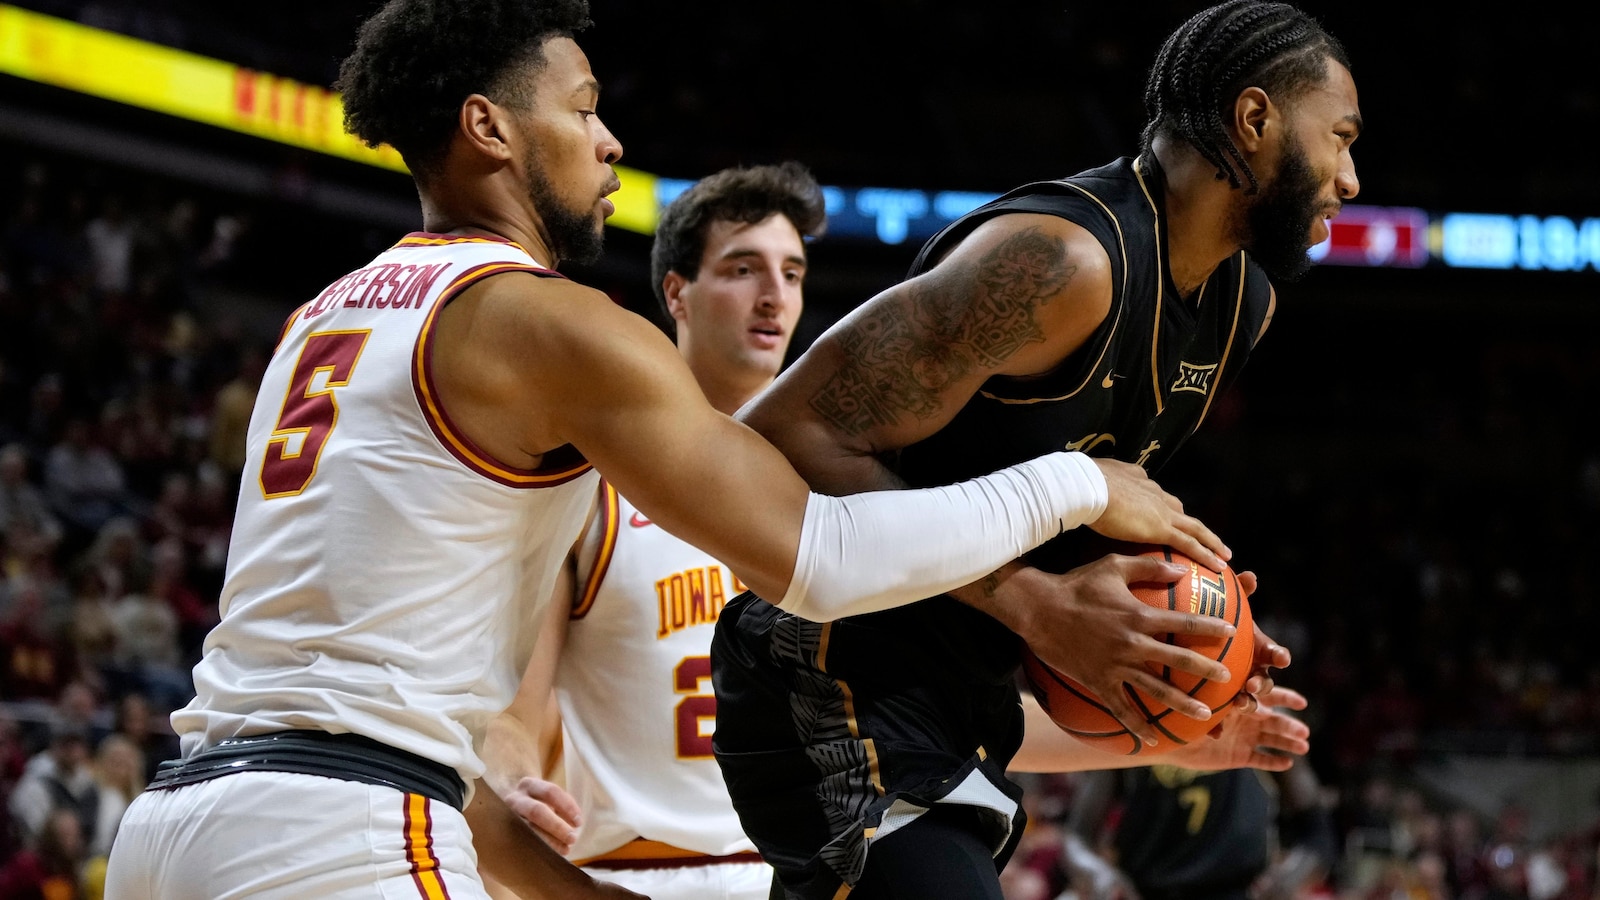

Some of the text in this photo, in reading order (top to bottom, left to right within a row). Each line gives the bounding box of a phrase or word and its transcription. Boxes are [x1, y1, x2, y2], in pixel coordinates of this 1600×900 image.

[304, 262, 453, 319] JEFFERSON
[258, 328, 373, 501] 5
[655, 565, 726, 640] IOWA
[673, 655, 718, 760] 2
[1178, 786, 1211, 834] 7
